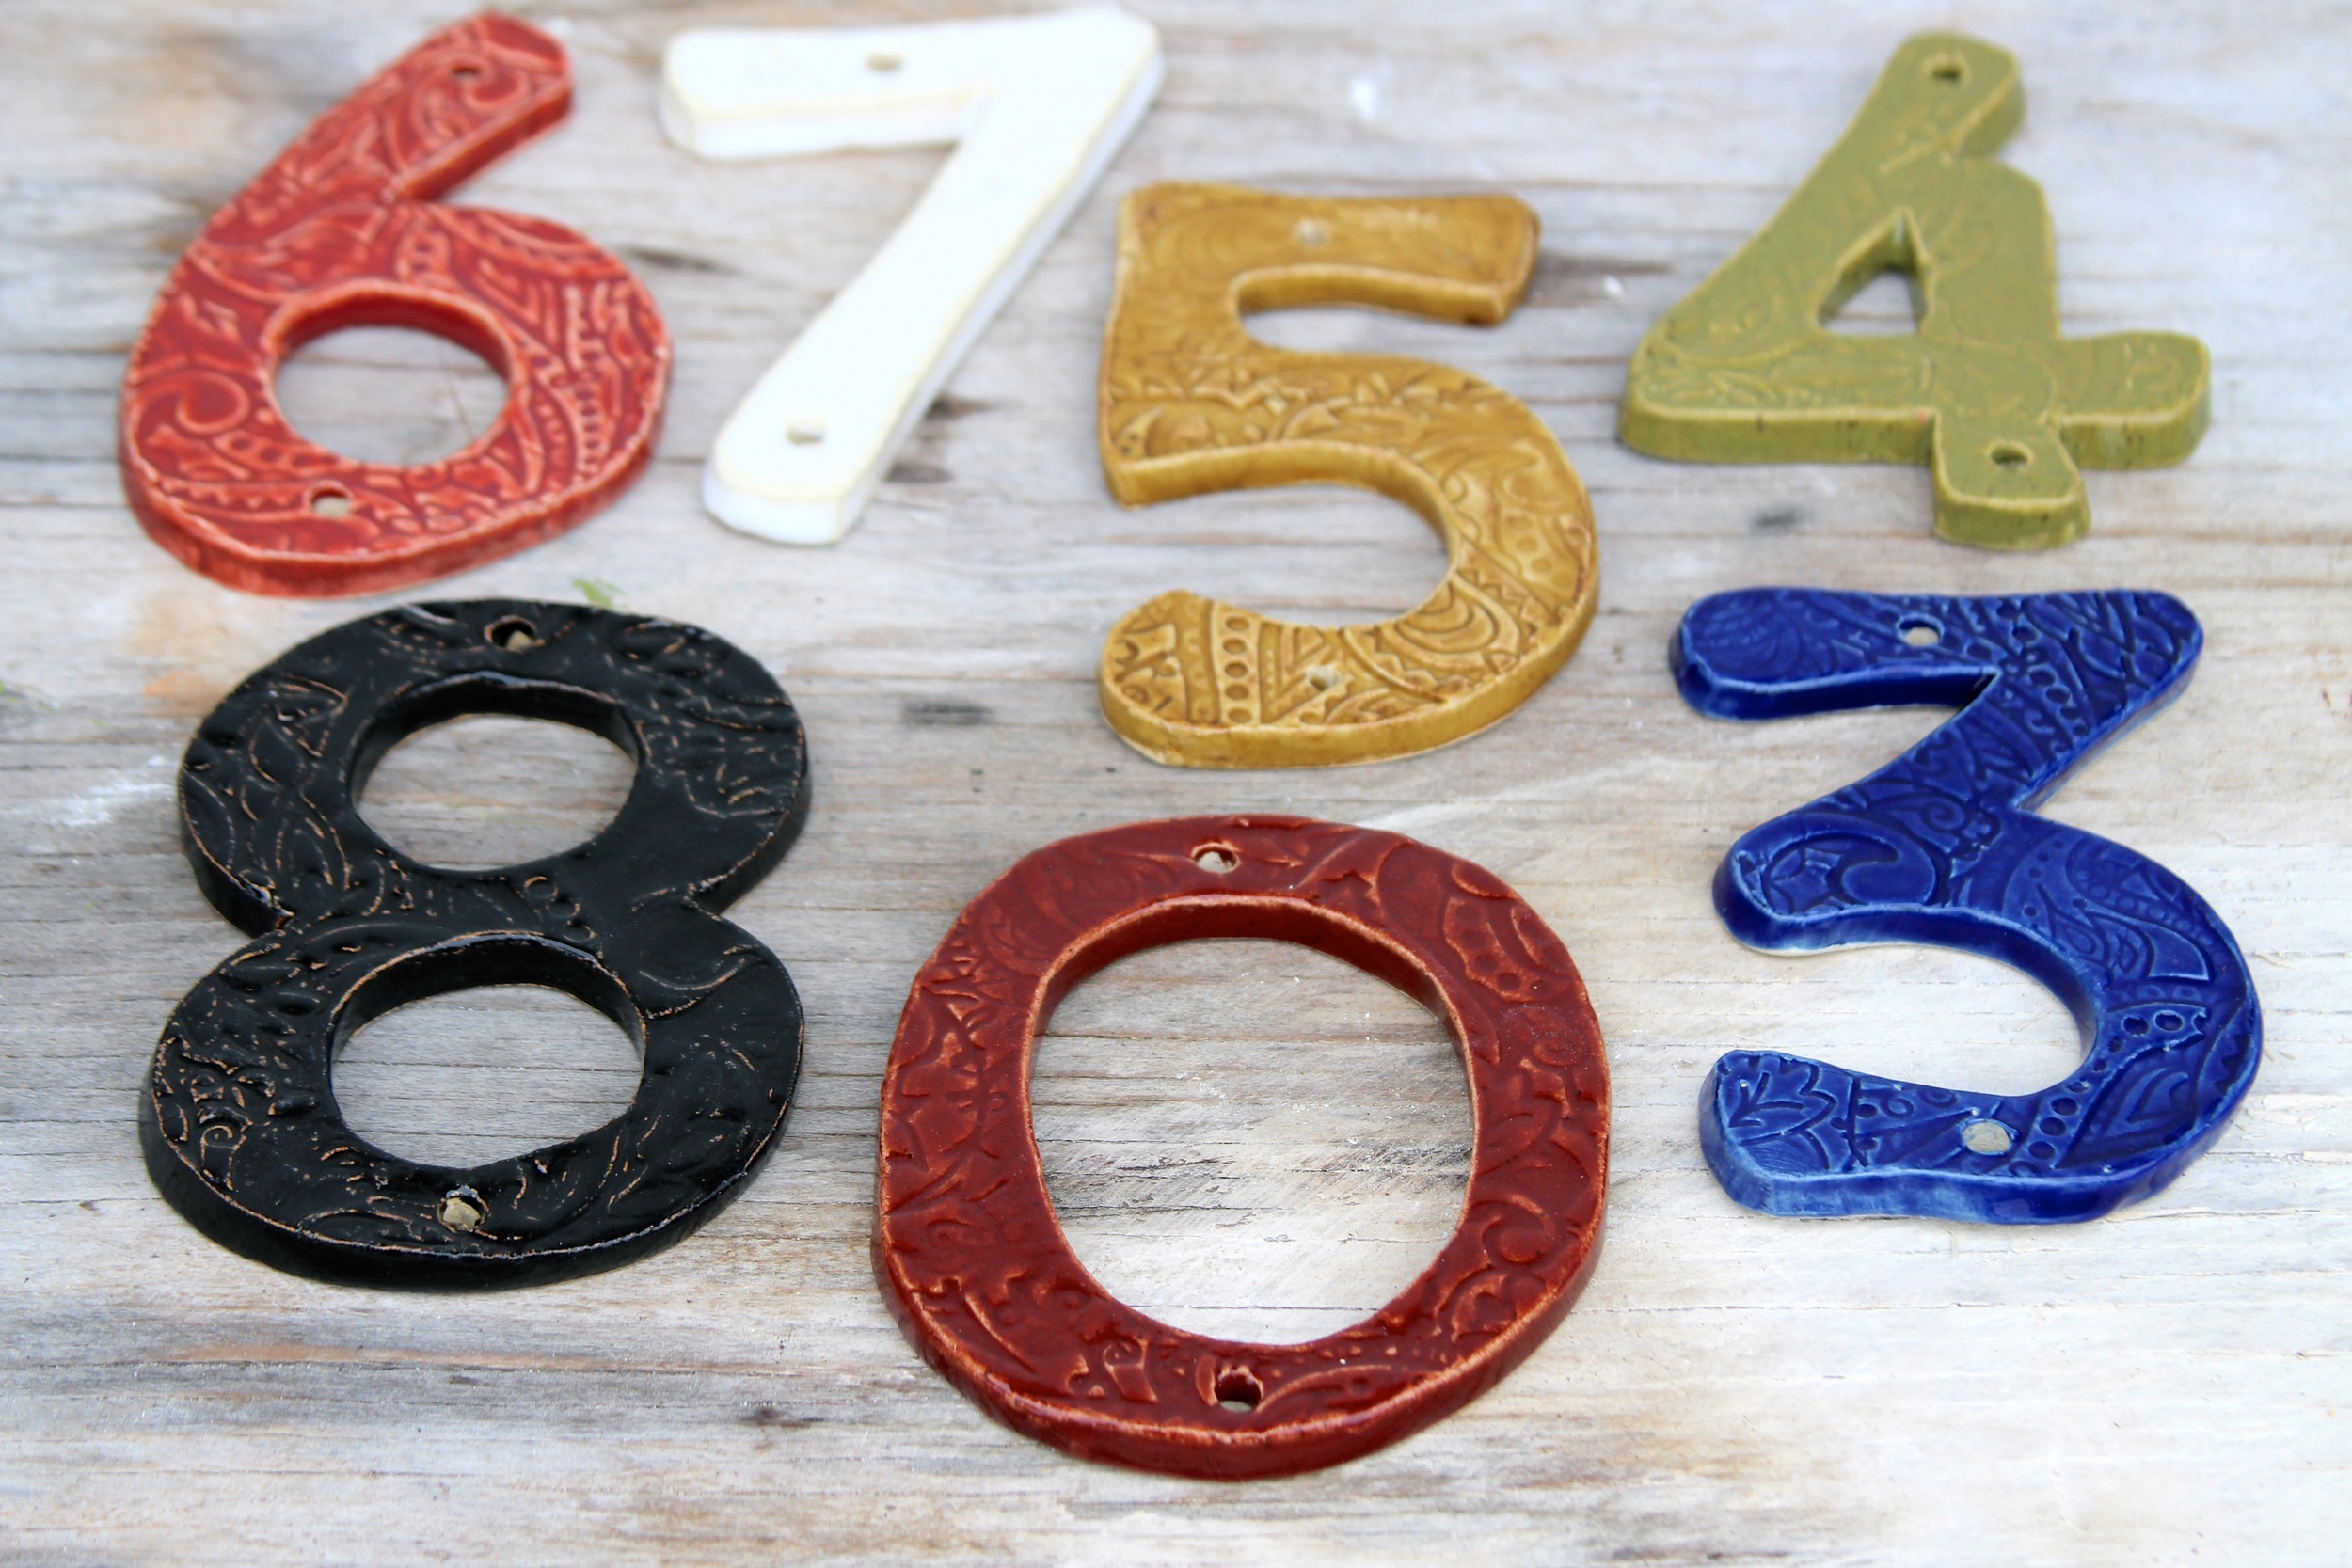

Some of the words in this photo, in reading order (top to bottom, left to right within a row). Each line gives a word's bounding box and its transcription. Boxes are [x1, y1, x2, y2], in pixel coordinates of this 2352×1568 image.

[120, 10, 675, 598] 6
[660, 8, 1164, 546] 7
[1099, 181, 1599, 768] 5
[1617, 31, 2211, 549] 4
[141, 599, 809, 1292] 8
[1671, 587, 2262, 1224] 3
